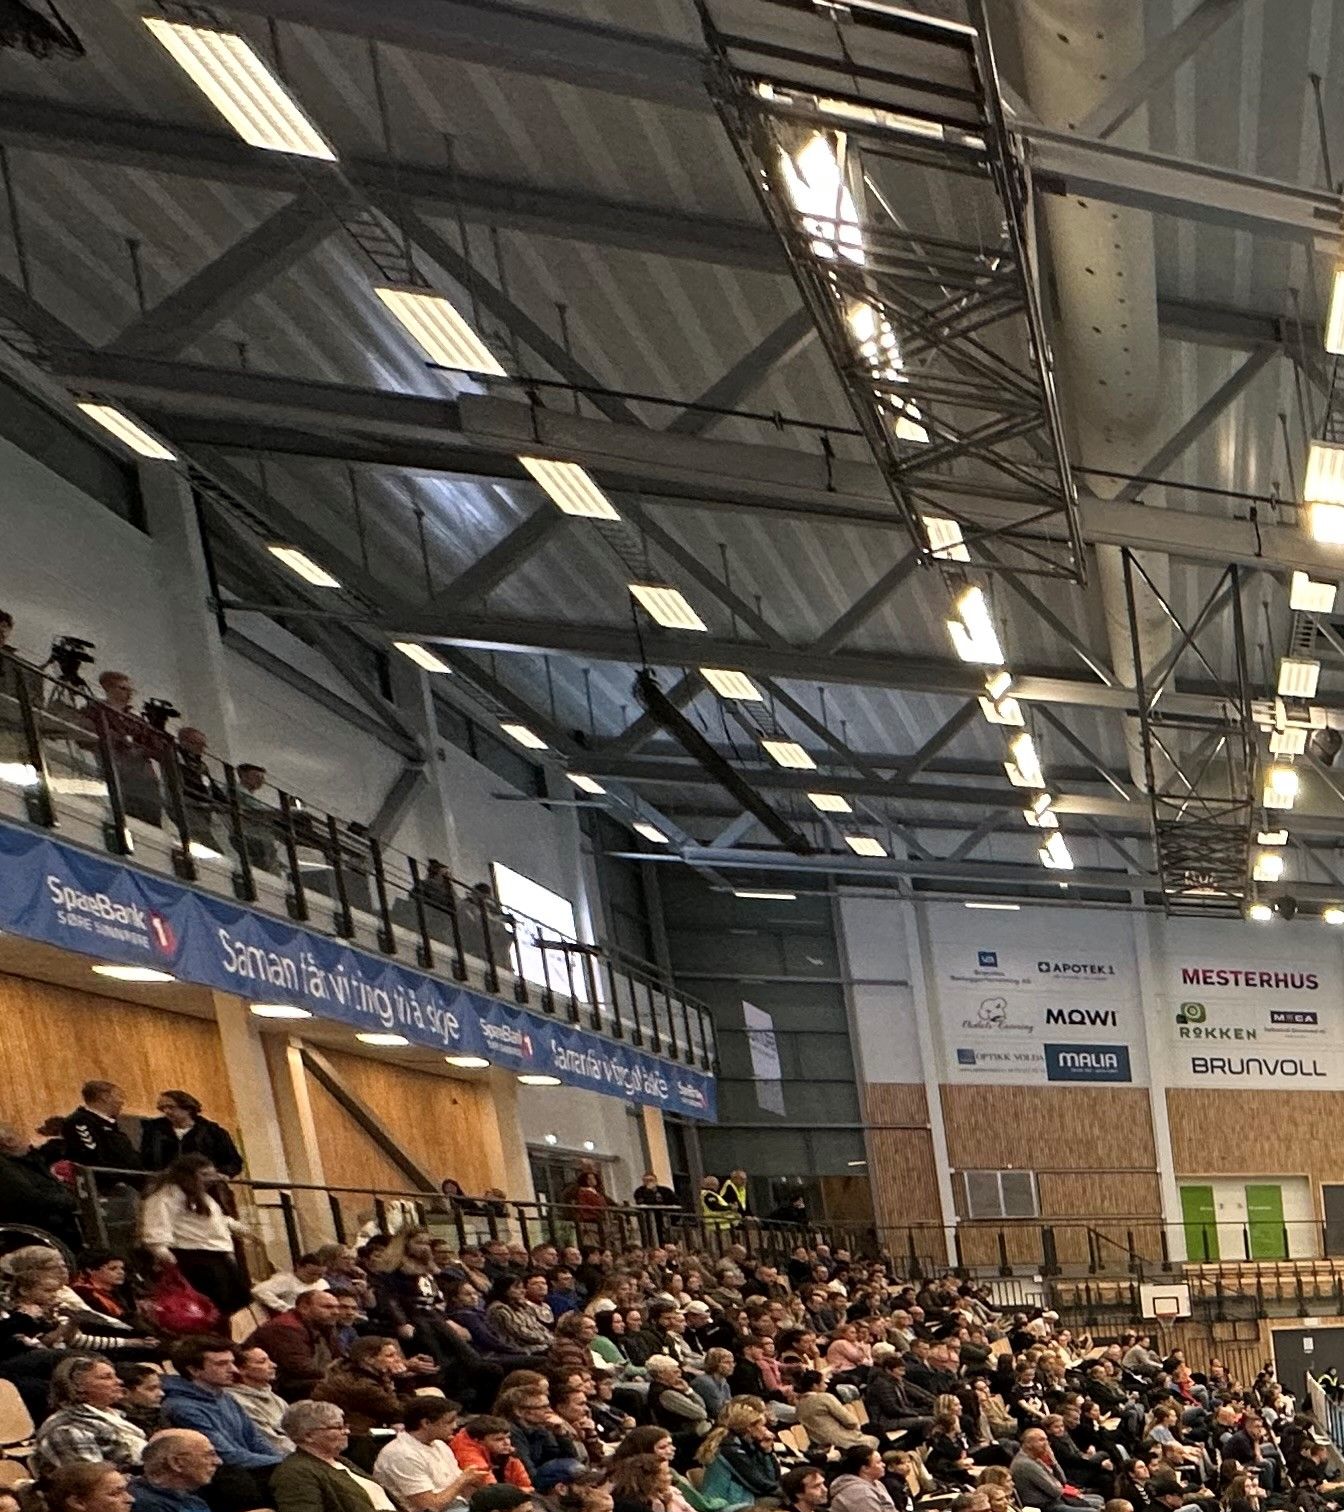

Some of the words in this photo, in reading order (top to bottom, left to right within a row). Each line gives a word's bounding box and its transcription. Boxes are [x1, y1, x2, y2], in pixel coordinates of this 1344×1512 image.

[217, 928, 299, 991] Saman
[1053, 963, 1106, 974] APOTEK
[1181, 968, 1319, 990] MESTERHUS
[1046, 1008, 1117, 1027] MOWI
[1058, 1052, 1118, 1068] MALIA
[1191, 1056, 1327, 1076] BRUNVOLL
